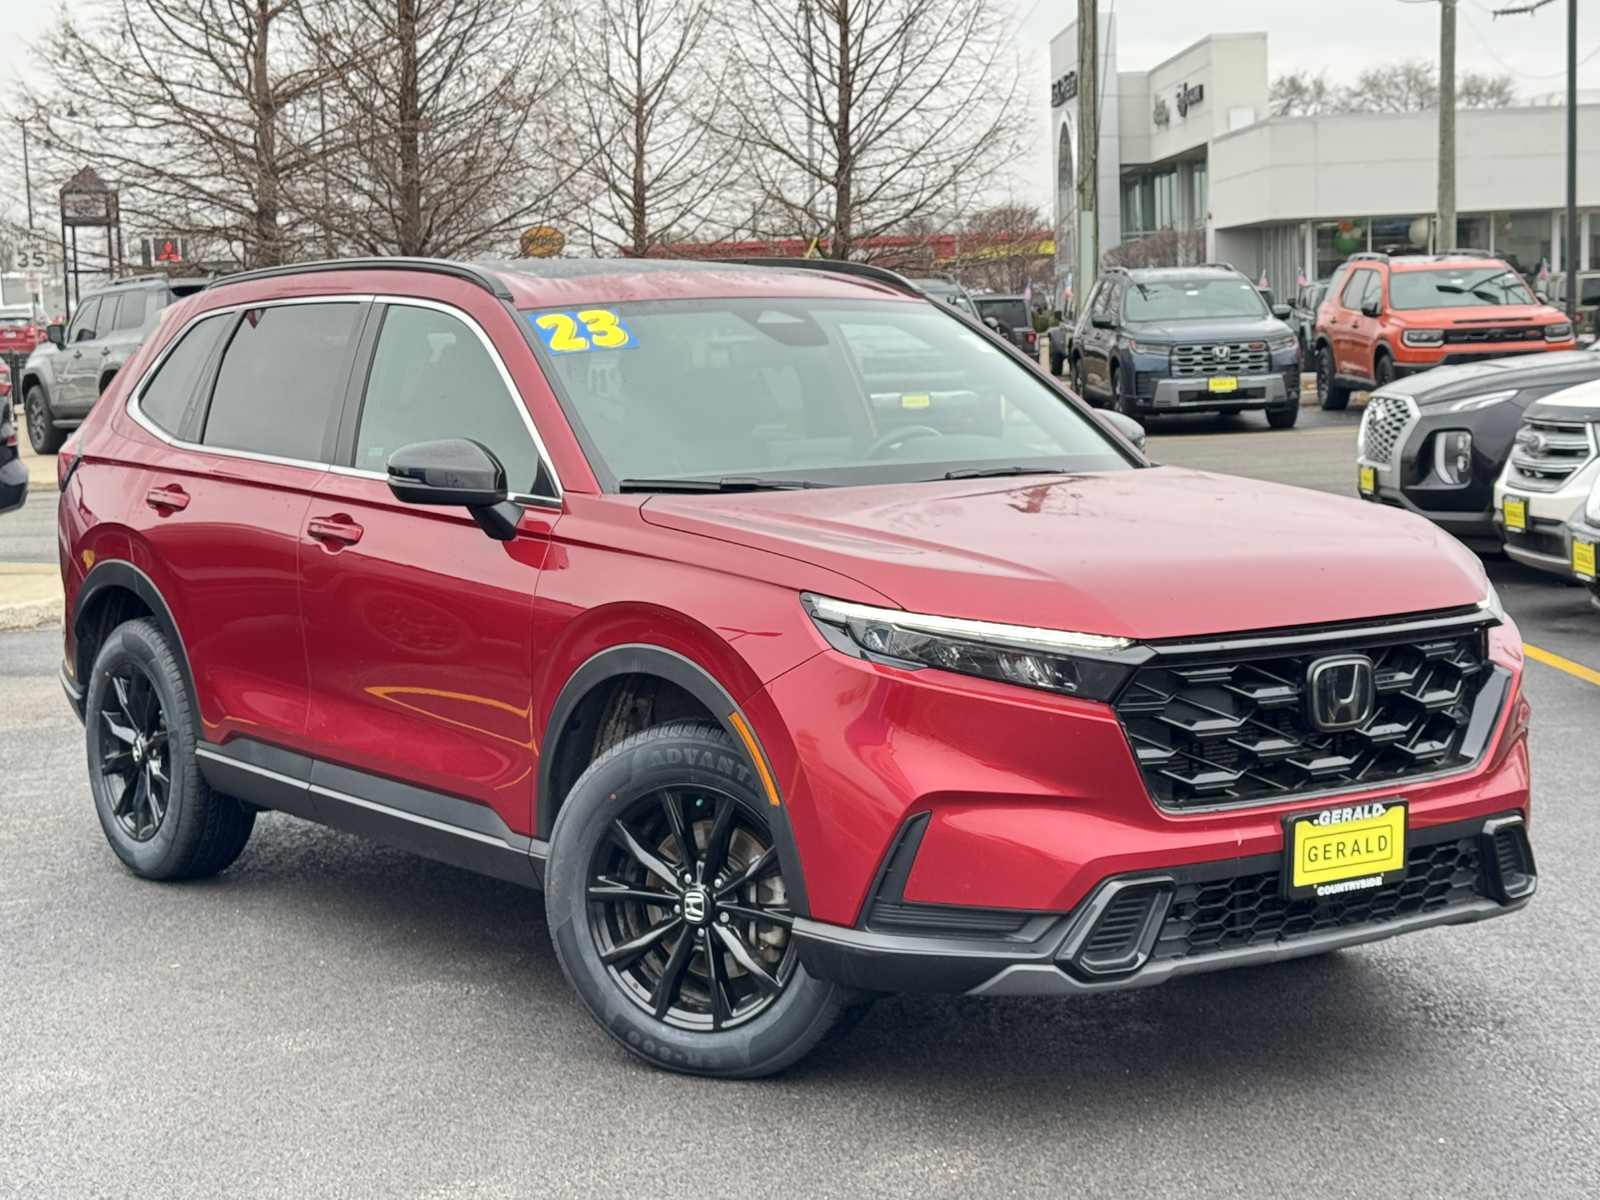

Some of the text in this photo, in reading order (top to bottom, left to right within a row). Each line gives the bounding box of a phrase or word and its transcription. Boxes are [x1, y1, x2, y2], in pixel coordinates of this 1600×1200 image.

[17, 251, 45, 268] 35
[535, 309, 630, 351] 23
[1318, 803, 1384, 826] GERALD
[1308, 835, 1388, 863] GERALD
[1316, 876, 1383, 896] COUNTRYSIDE
